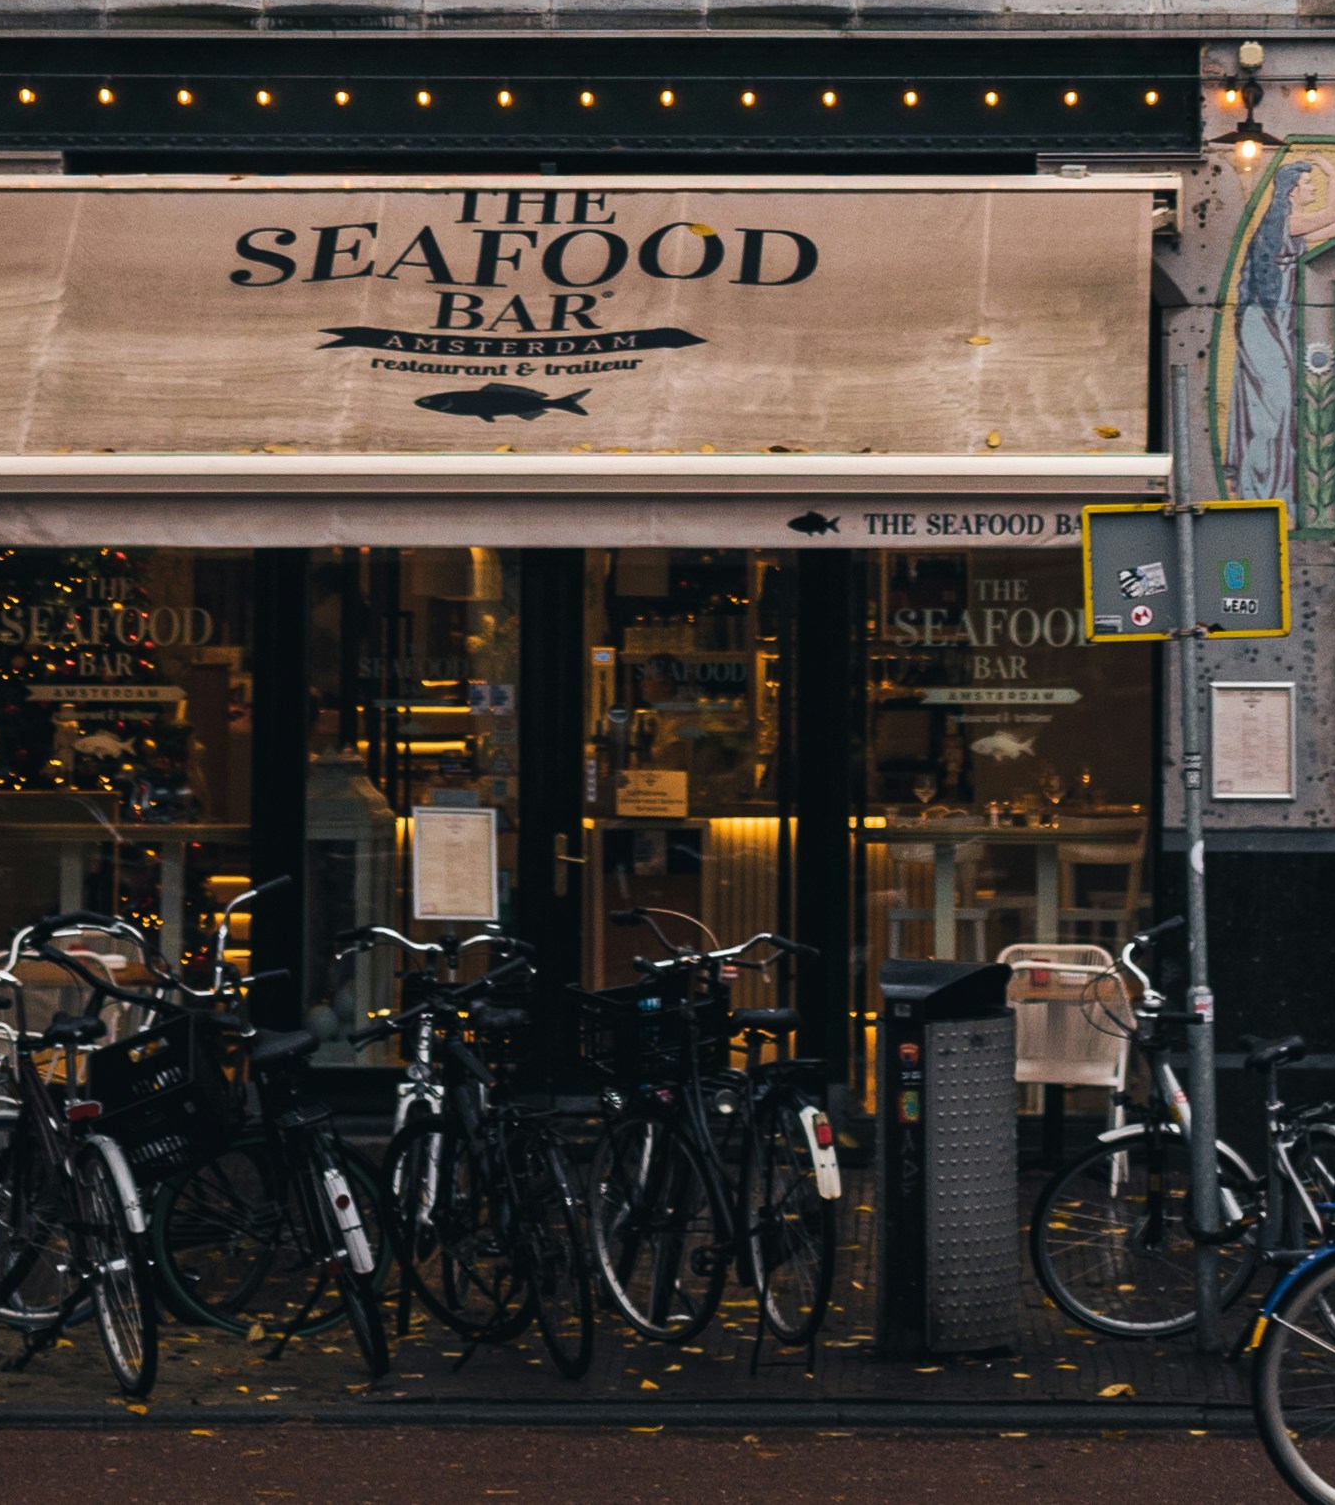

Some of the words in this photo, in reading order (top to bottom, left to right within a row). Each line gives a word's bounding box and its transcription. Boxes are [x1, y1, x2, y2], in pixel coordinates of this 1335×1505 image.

[446, 191, 617, 225] THE
[229, 221, 819, 287] SEAFOOD
[383, 334, 640, 355] AMSTERDAM
[371, 356, 509, 377] restaurant
[515, 361, 538, 378] &
[543, 355, 643, 377] traiteur
[864, 513, 915, 535] THE
[926, 513, 1045, 535] SEAFOOD
[84, 577, 135, 600] THE
[975, 579, 1029, 602] THE
[0, 606, 215, 646] SEAFOOD
[78, 652, 134, 677] BAR
[973, 656, 1029, 680] BAR
